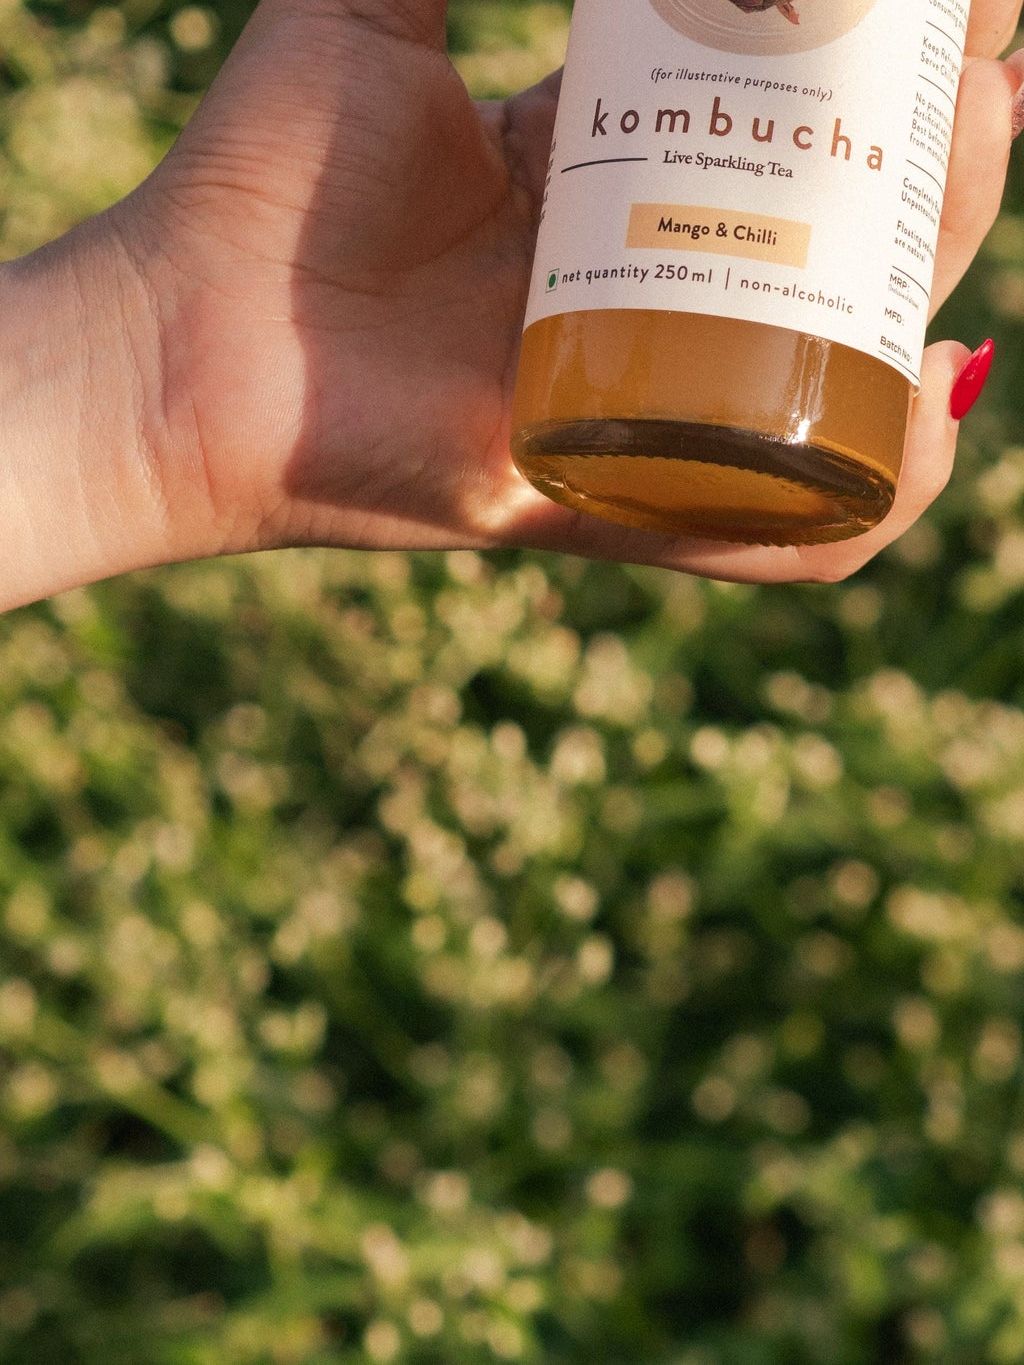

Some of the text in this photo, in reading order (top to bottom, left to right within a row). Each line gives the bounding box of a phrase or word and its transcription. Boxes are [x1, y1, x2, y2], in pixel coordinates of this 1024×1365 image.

[922, 36, 939, 57] Keep
[920, 51, 939, 71] Serve
[650, 67, 834, 102] (for illustrative purposes only)
[916, 91, 926, 105] No
[591, 96, 884, 172] kombucha
[912, 118, 927, 136] Best
[909, 132, 926, 150] from
[662, 150, 794, 179] Live Sparkling Tea
[657, 217, 778, 246] Mango & Chilli
[897, 220, 922, 248] Floating
[894, 237, 906, 248] are
[562, 269, 581, 283] net
[585, 265, 649, 284] quantity
[740, 277, 854, 315] non-alcoholic
[889, 273, 911, 292] MRP:
[884, 307, 905, 327] MFD:
[880, 335, 902, 355] Batch
